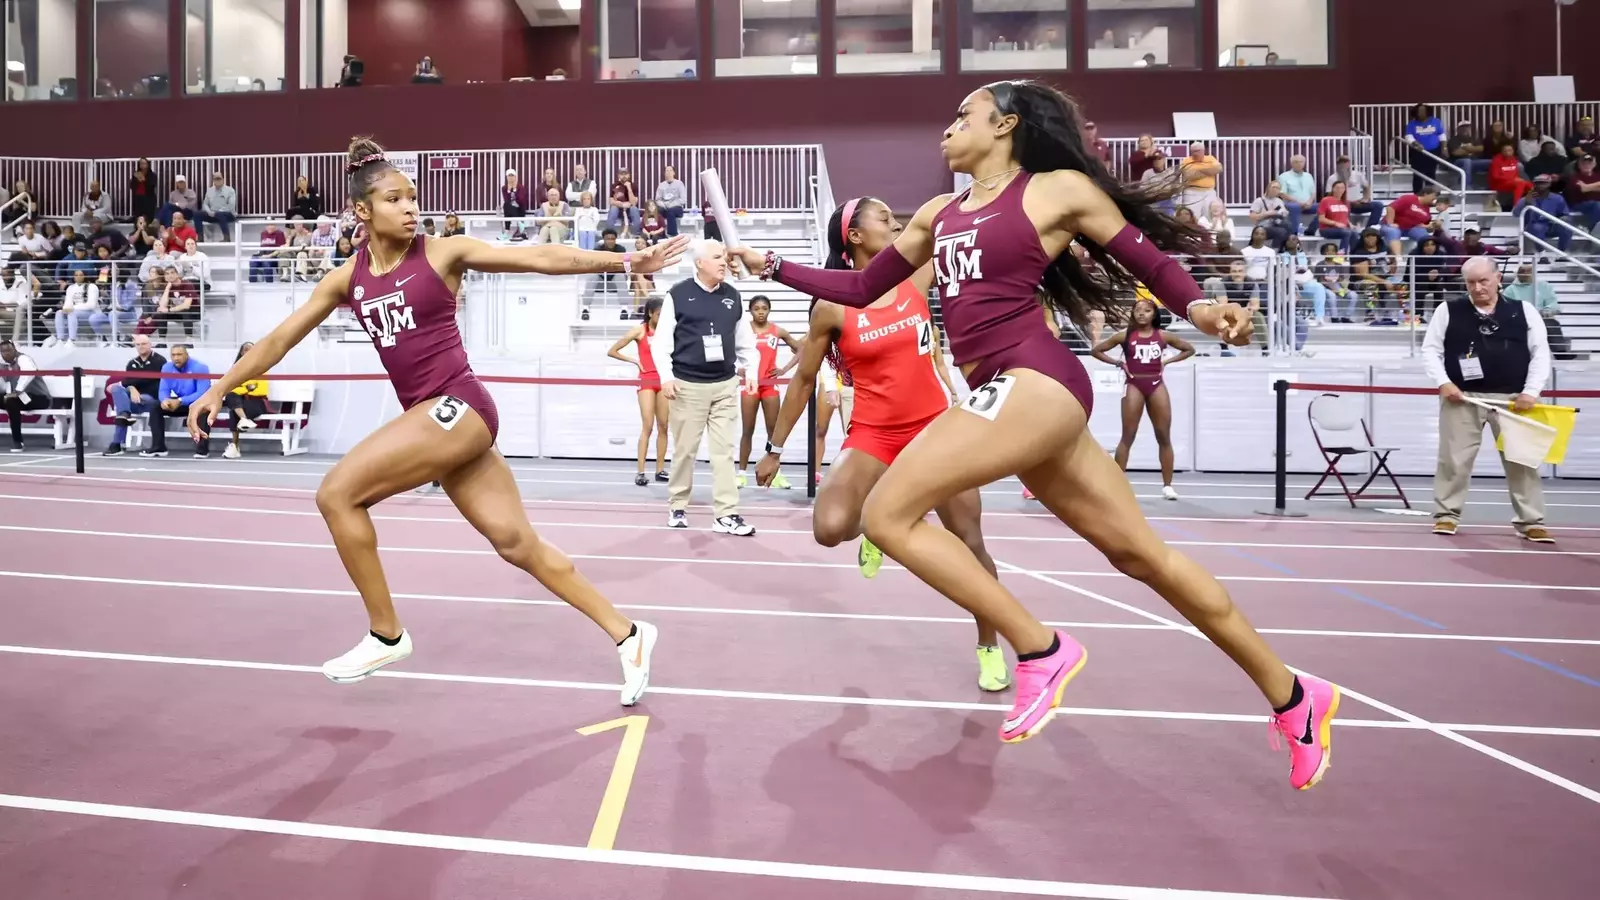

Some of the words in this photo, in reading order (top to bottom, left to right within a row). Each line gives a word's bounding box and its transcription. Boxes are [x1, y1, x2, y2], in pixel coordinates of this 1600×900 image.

[443, 158, 459, 168] 103
[857, 313, 871, 328] A
[859, 313, 923, 343] HOUSTON
[769, 337, 776, 346] 4
[920, 322, 931, 350] 4
[1151, 347, 1160, 357] 5
[969, 377, 1007, 412] 5
[435, 395, 464, 423] 5
[574, 715, 650, 851] 1
